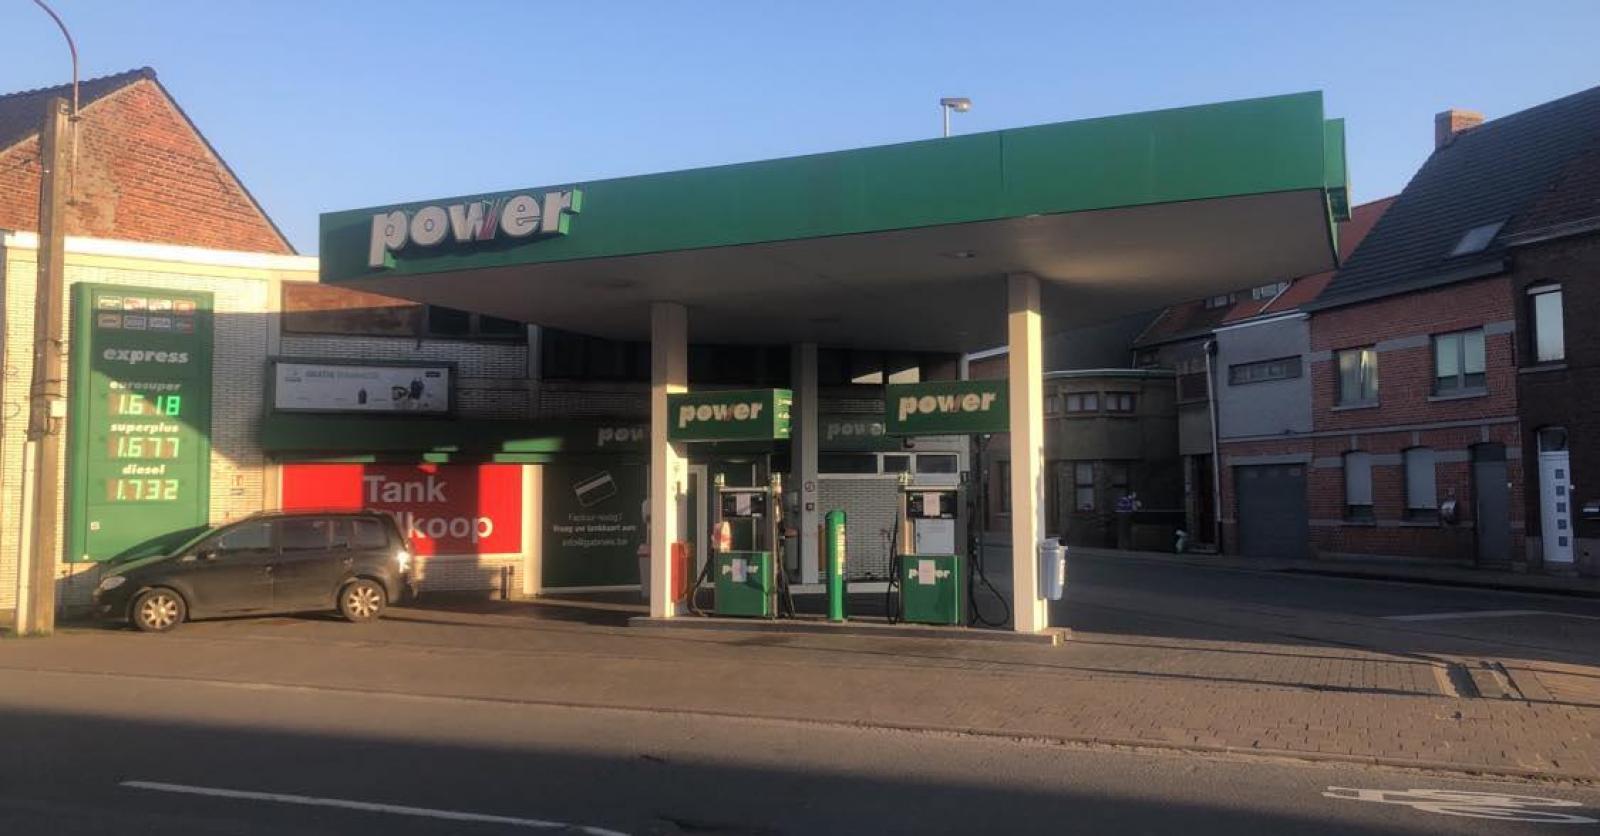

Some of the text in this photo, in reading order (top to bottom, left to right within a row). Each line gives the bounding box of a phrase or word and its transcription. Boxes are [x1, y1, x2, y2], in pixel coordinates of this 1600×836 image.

[369, 190, 579, 268] power
[103, 350, 189, 364] express
[109, 381, 181, 391] eurosuper
[678, 401, 763, 428] power
[898, 391, 997, 421] power
[111, 422, 179, 434] superplus
[597, 427, 648, 446] pow
[118, 437, 179, 458] 1.677
[122, 464, 166, 475] diesel
[117, 479, 179, 500] 1.732
[363, 473, 448, 503] Tank
[394, 511, 494, 544] koop
[908, 568, 951, 580] per
